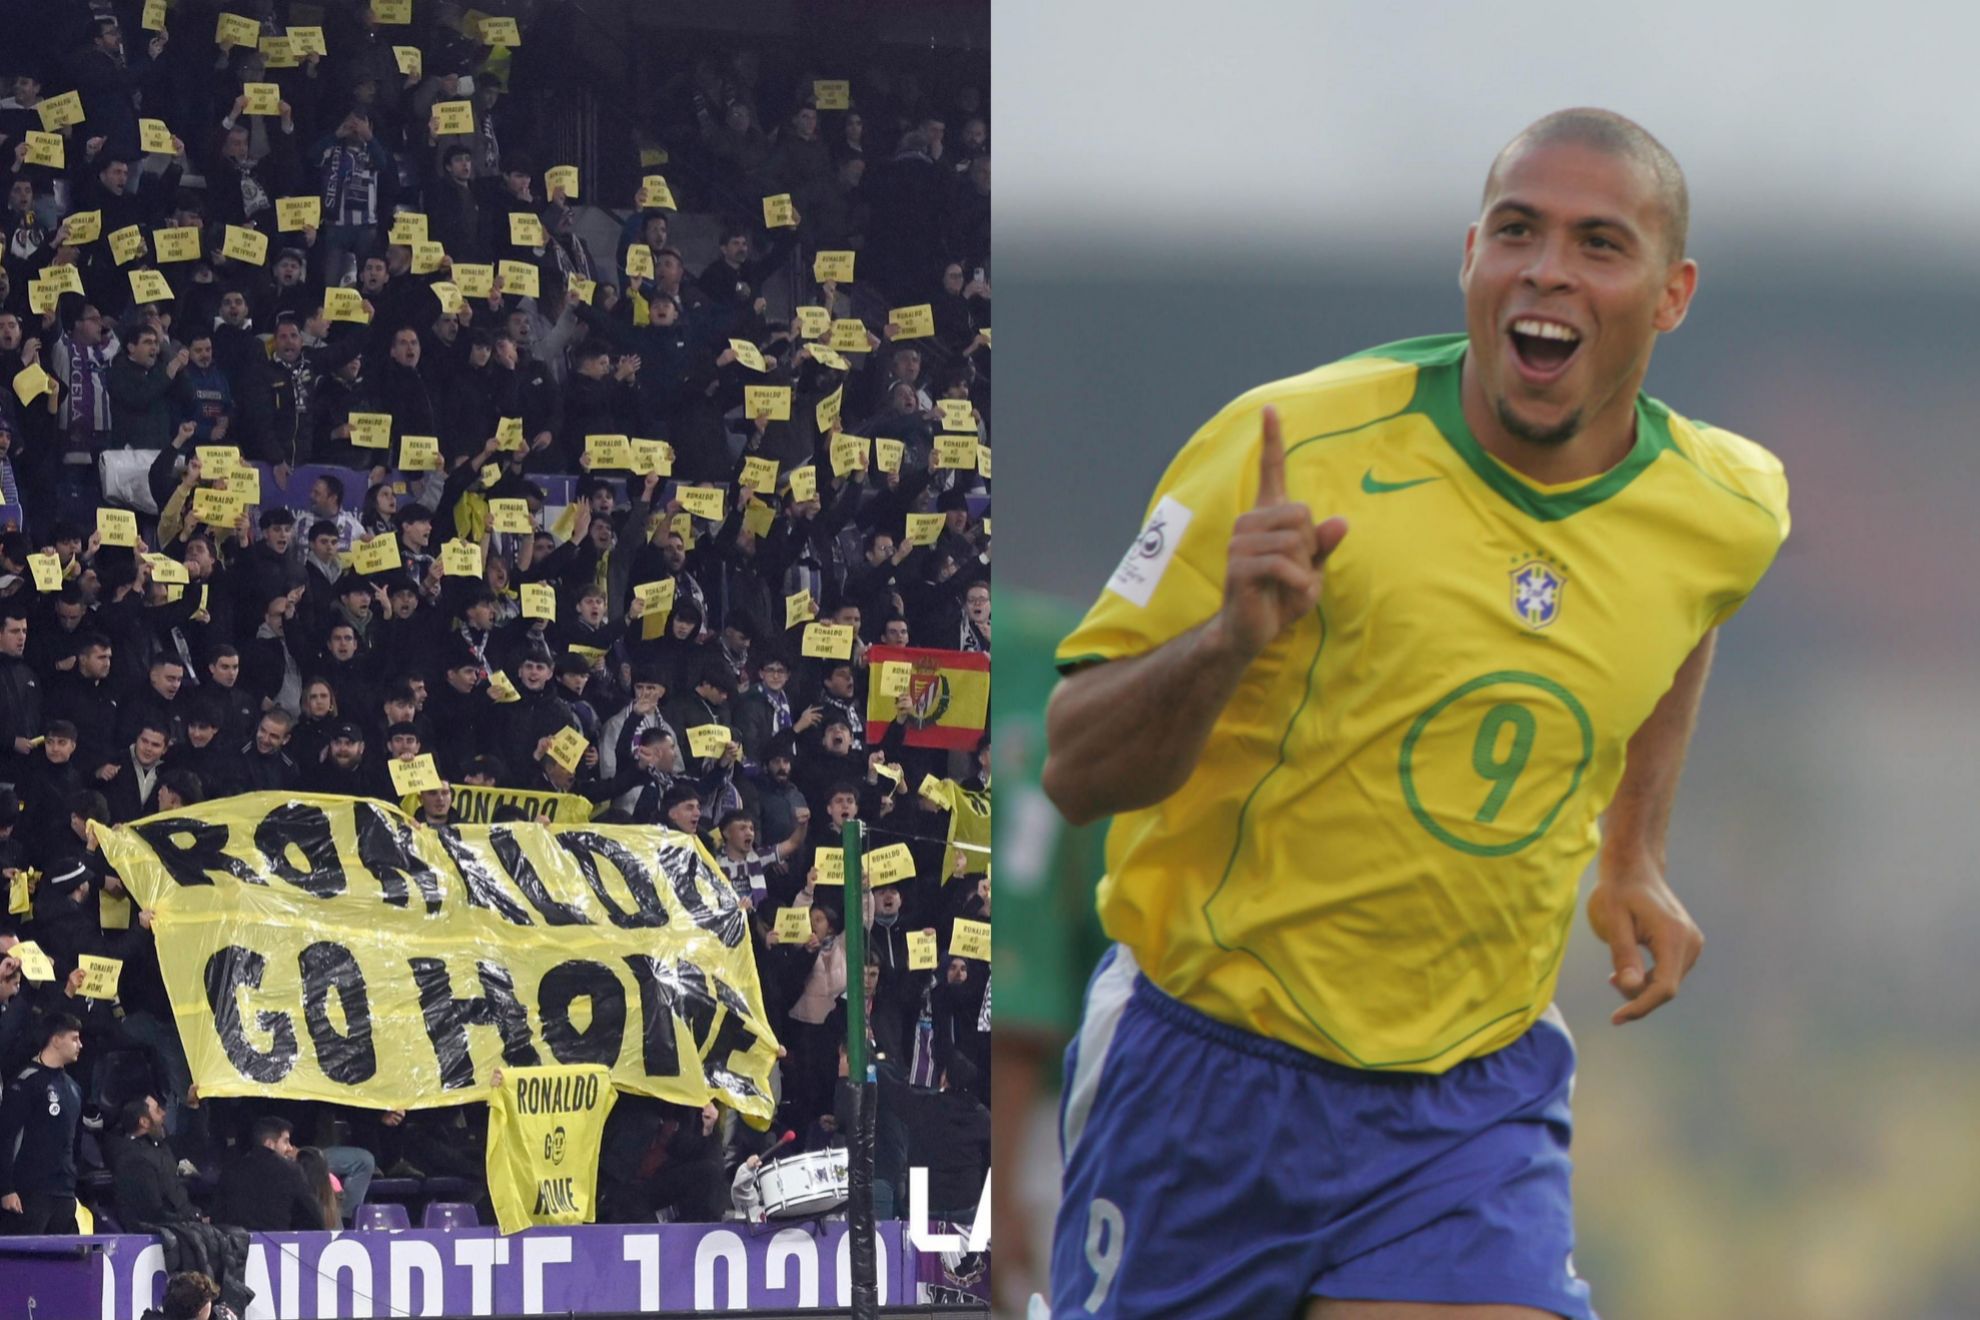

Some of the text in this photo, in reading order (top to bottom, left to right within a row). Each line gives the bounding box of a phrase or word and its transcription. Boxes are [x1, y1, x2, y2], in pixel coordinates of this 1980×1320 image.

[1472, 702, 1537, 822] 9
[130, 800, 748, 948] RONALDO
[203, 940, 773, 1103] GO HOME
[517, 1073, 598, 1115] RONALDO
[533, 1177, 579, 1215] HOME
[1083, 1198, 1125, 1313] 9
